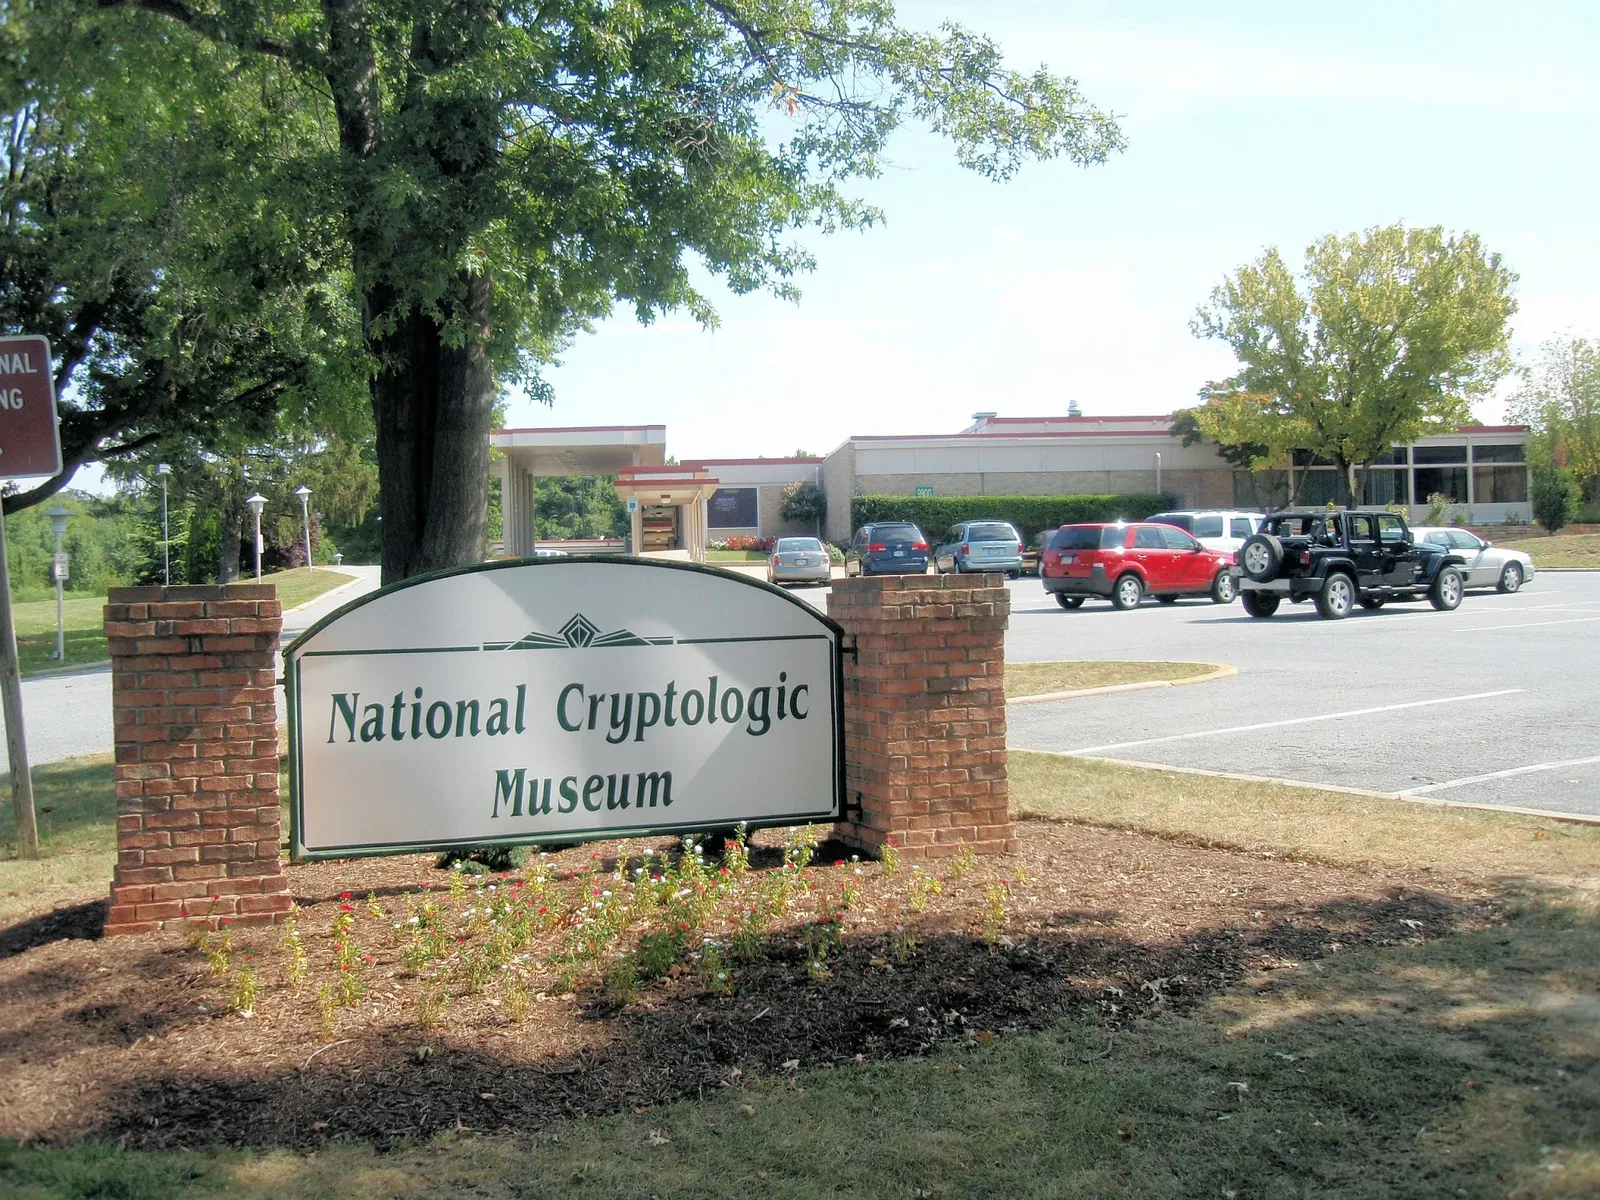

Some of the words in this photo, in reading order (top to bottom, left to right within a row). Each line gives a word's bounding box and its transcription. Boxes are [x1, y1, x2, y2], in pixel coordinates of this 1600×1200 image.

[327, 684, 526, 744] National
[557, 671, 809, 744] Cryptologic
[492, 768, 673, 818] Museum
